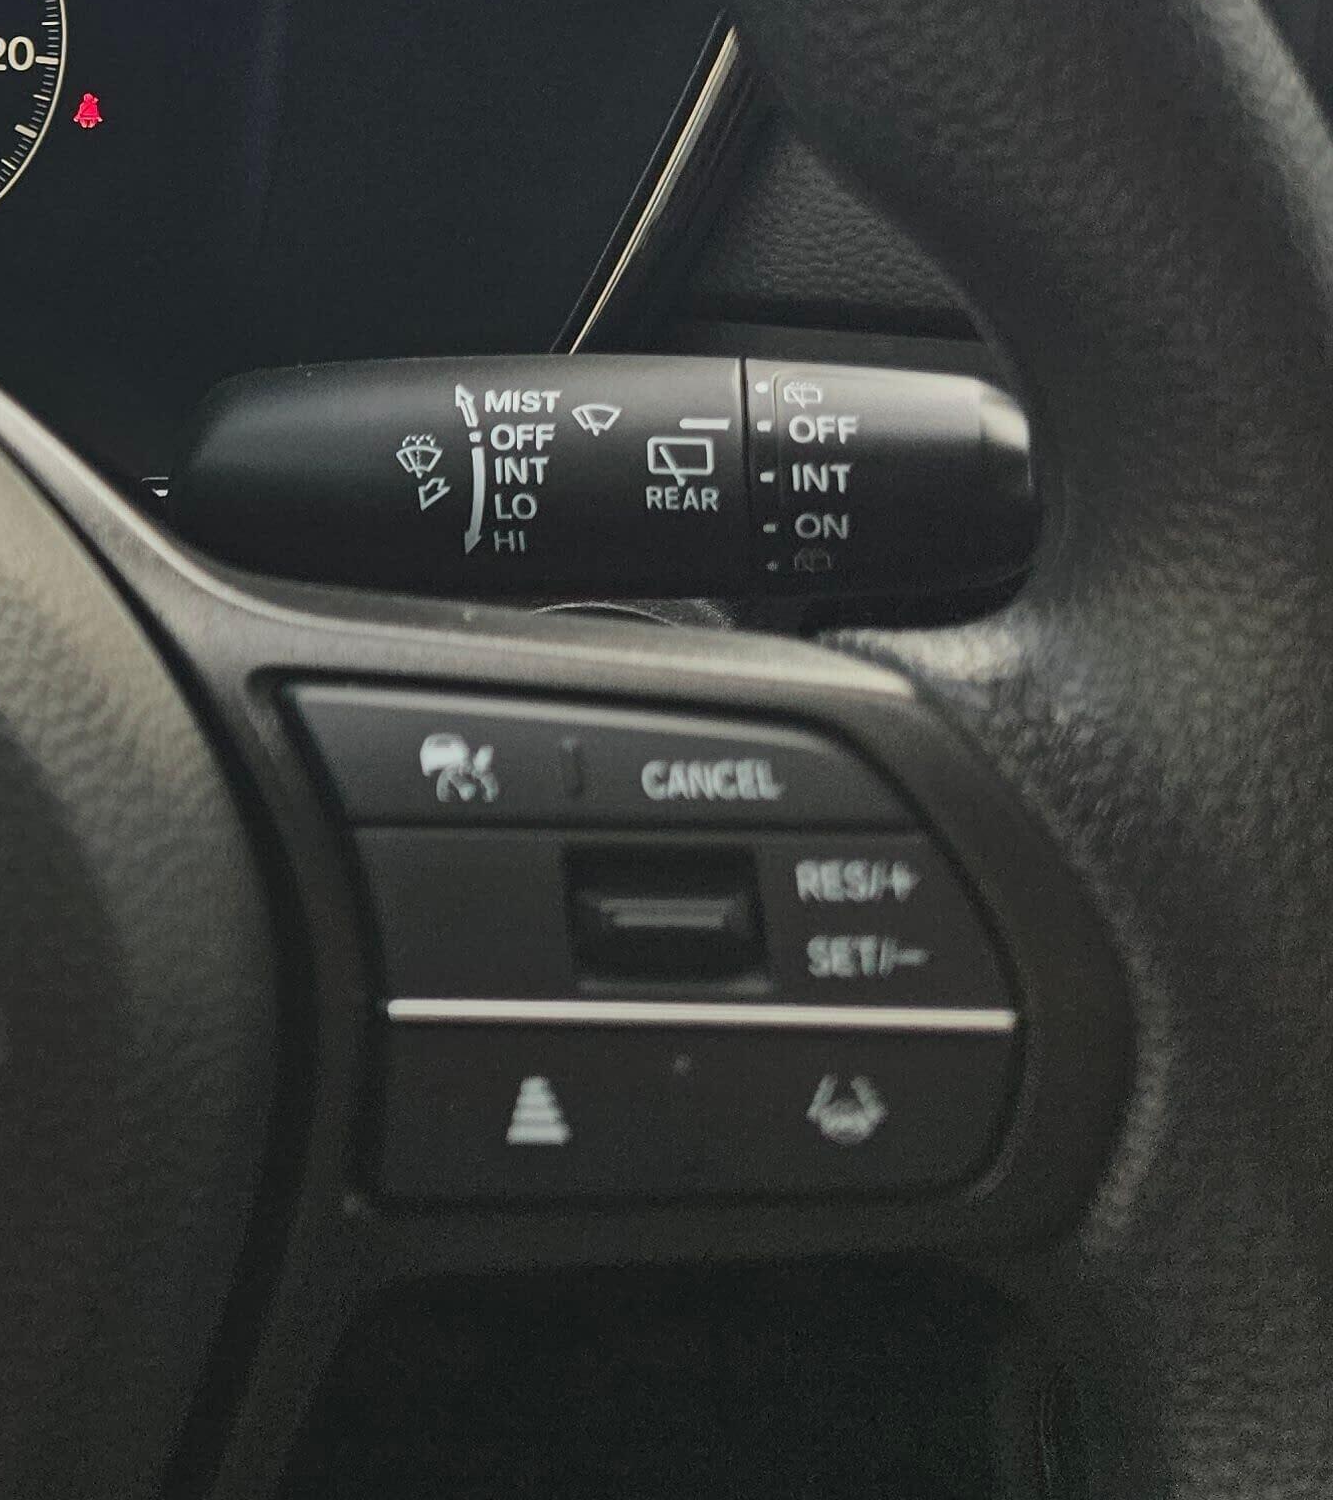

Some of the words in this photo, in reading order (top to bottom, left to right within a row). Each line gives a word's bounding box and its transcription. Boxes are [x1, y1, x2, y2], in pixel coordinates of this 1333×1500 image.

[485, 390, 560, 413] MIST
[491, 424, 554, 450] OFF
[789, 417, 856, 444] OFF
[495, 457, 548, 484] INT
[793, 464, 850, 492] INT
[495, 493, 537, 519] LO
[646, 486, 719, 511] REAR
[795, 513, 848, 539] ON
[494, 531, 525, 551] HI
[641, 759, 782, 800] CANCEL
